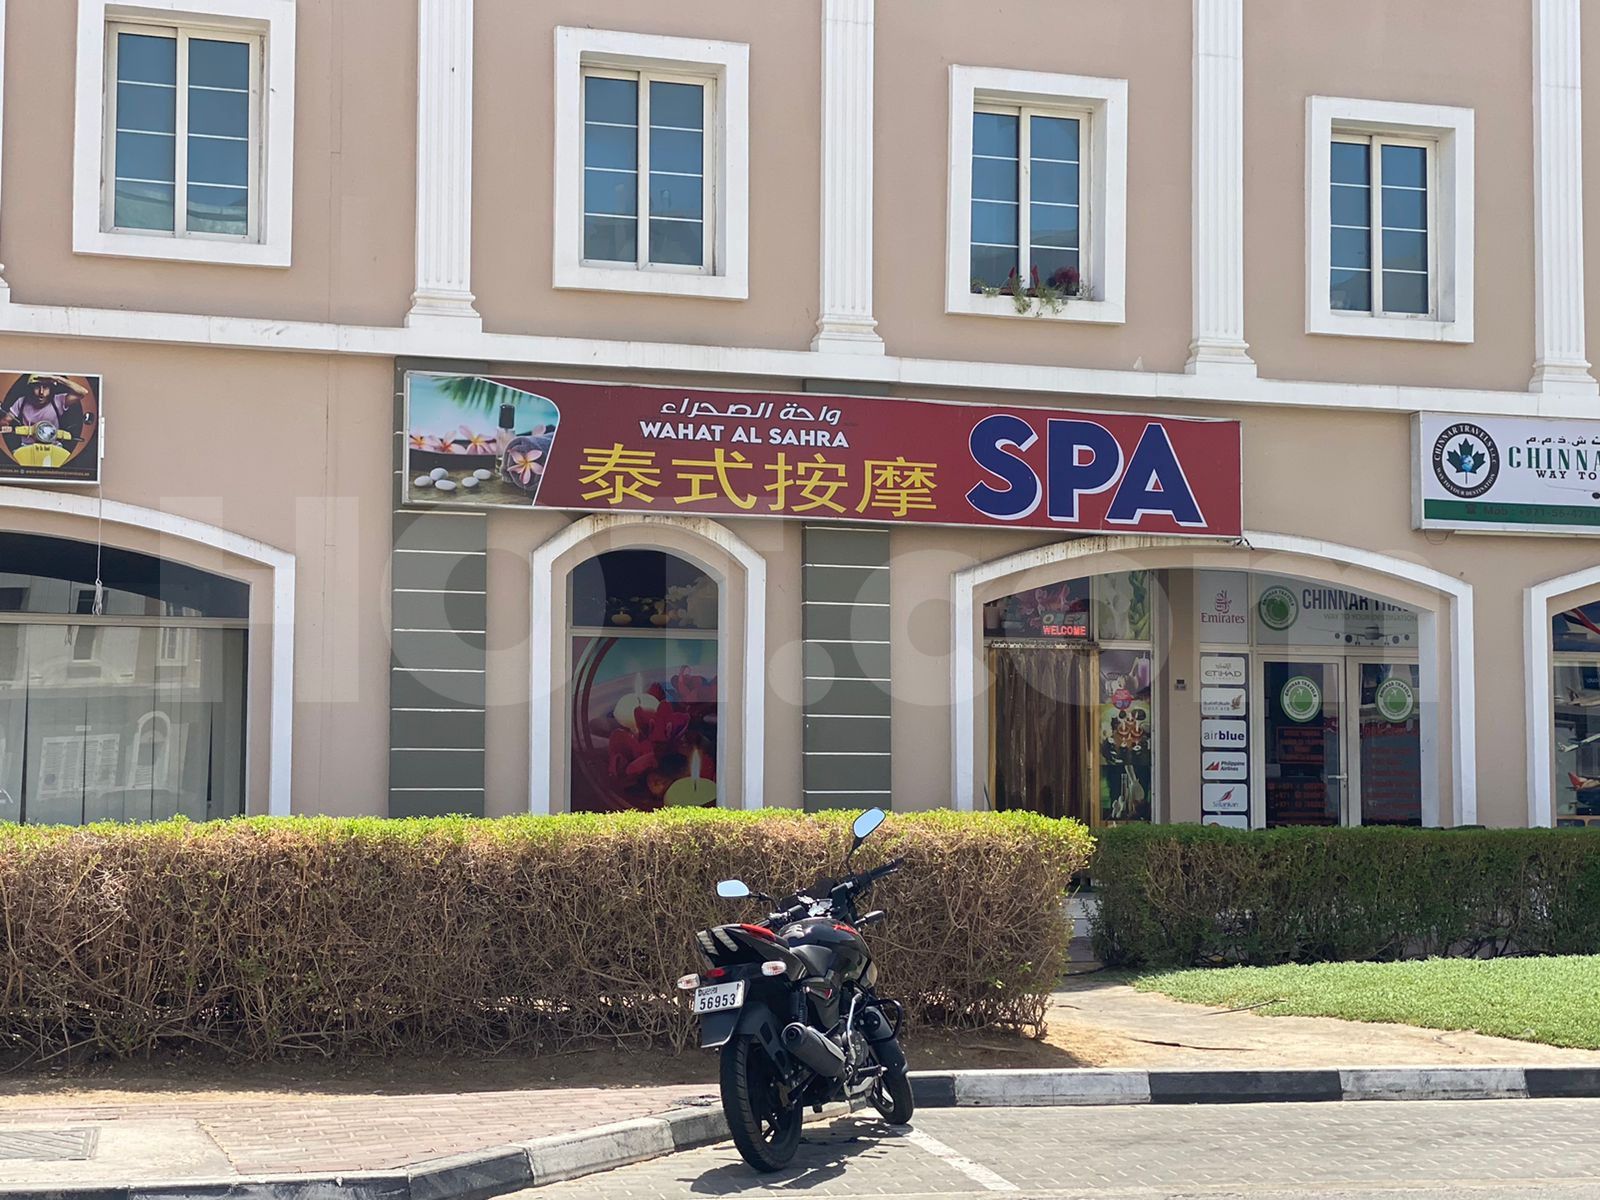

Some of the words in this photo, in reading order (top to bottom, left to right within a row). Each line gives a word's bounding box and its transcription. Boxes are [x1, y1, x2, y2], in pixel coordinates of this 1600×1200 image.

[660, 397, 774, 419] الصحراء
[779, 402, 842, 426] واحة
[639, 420, 725, 442] WAHAT
[730, 426, 763, 444] AL
[768, 427, 850, 448] SAHRA
[1433, 426, 1458, 461] CHINNAR
[1459, 424, 1493, 448] TRAVELS
[965, 413, 1208, 529] SPA
[1535, 470, 1567, 479] WAY
[1578, 471, 1598, 481] TO
[578, 443, 939, 518] 泰式按摩
[1201, 612, 1245, 624] Emirates
[1042, 625, 1087, 636] WELCOME
[1204, 670, 1242, 678] ETIHAD
[1203, 730, 1245, 741] airblue
[1220, 760, 1245, 768] Philippine
[700, 994, 736, 1010] 56953
